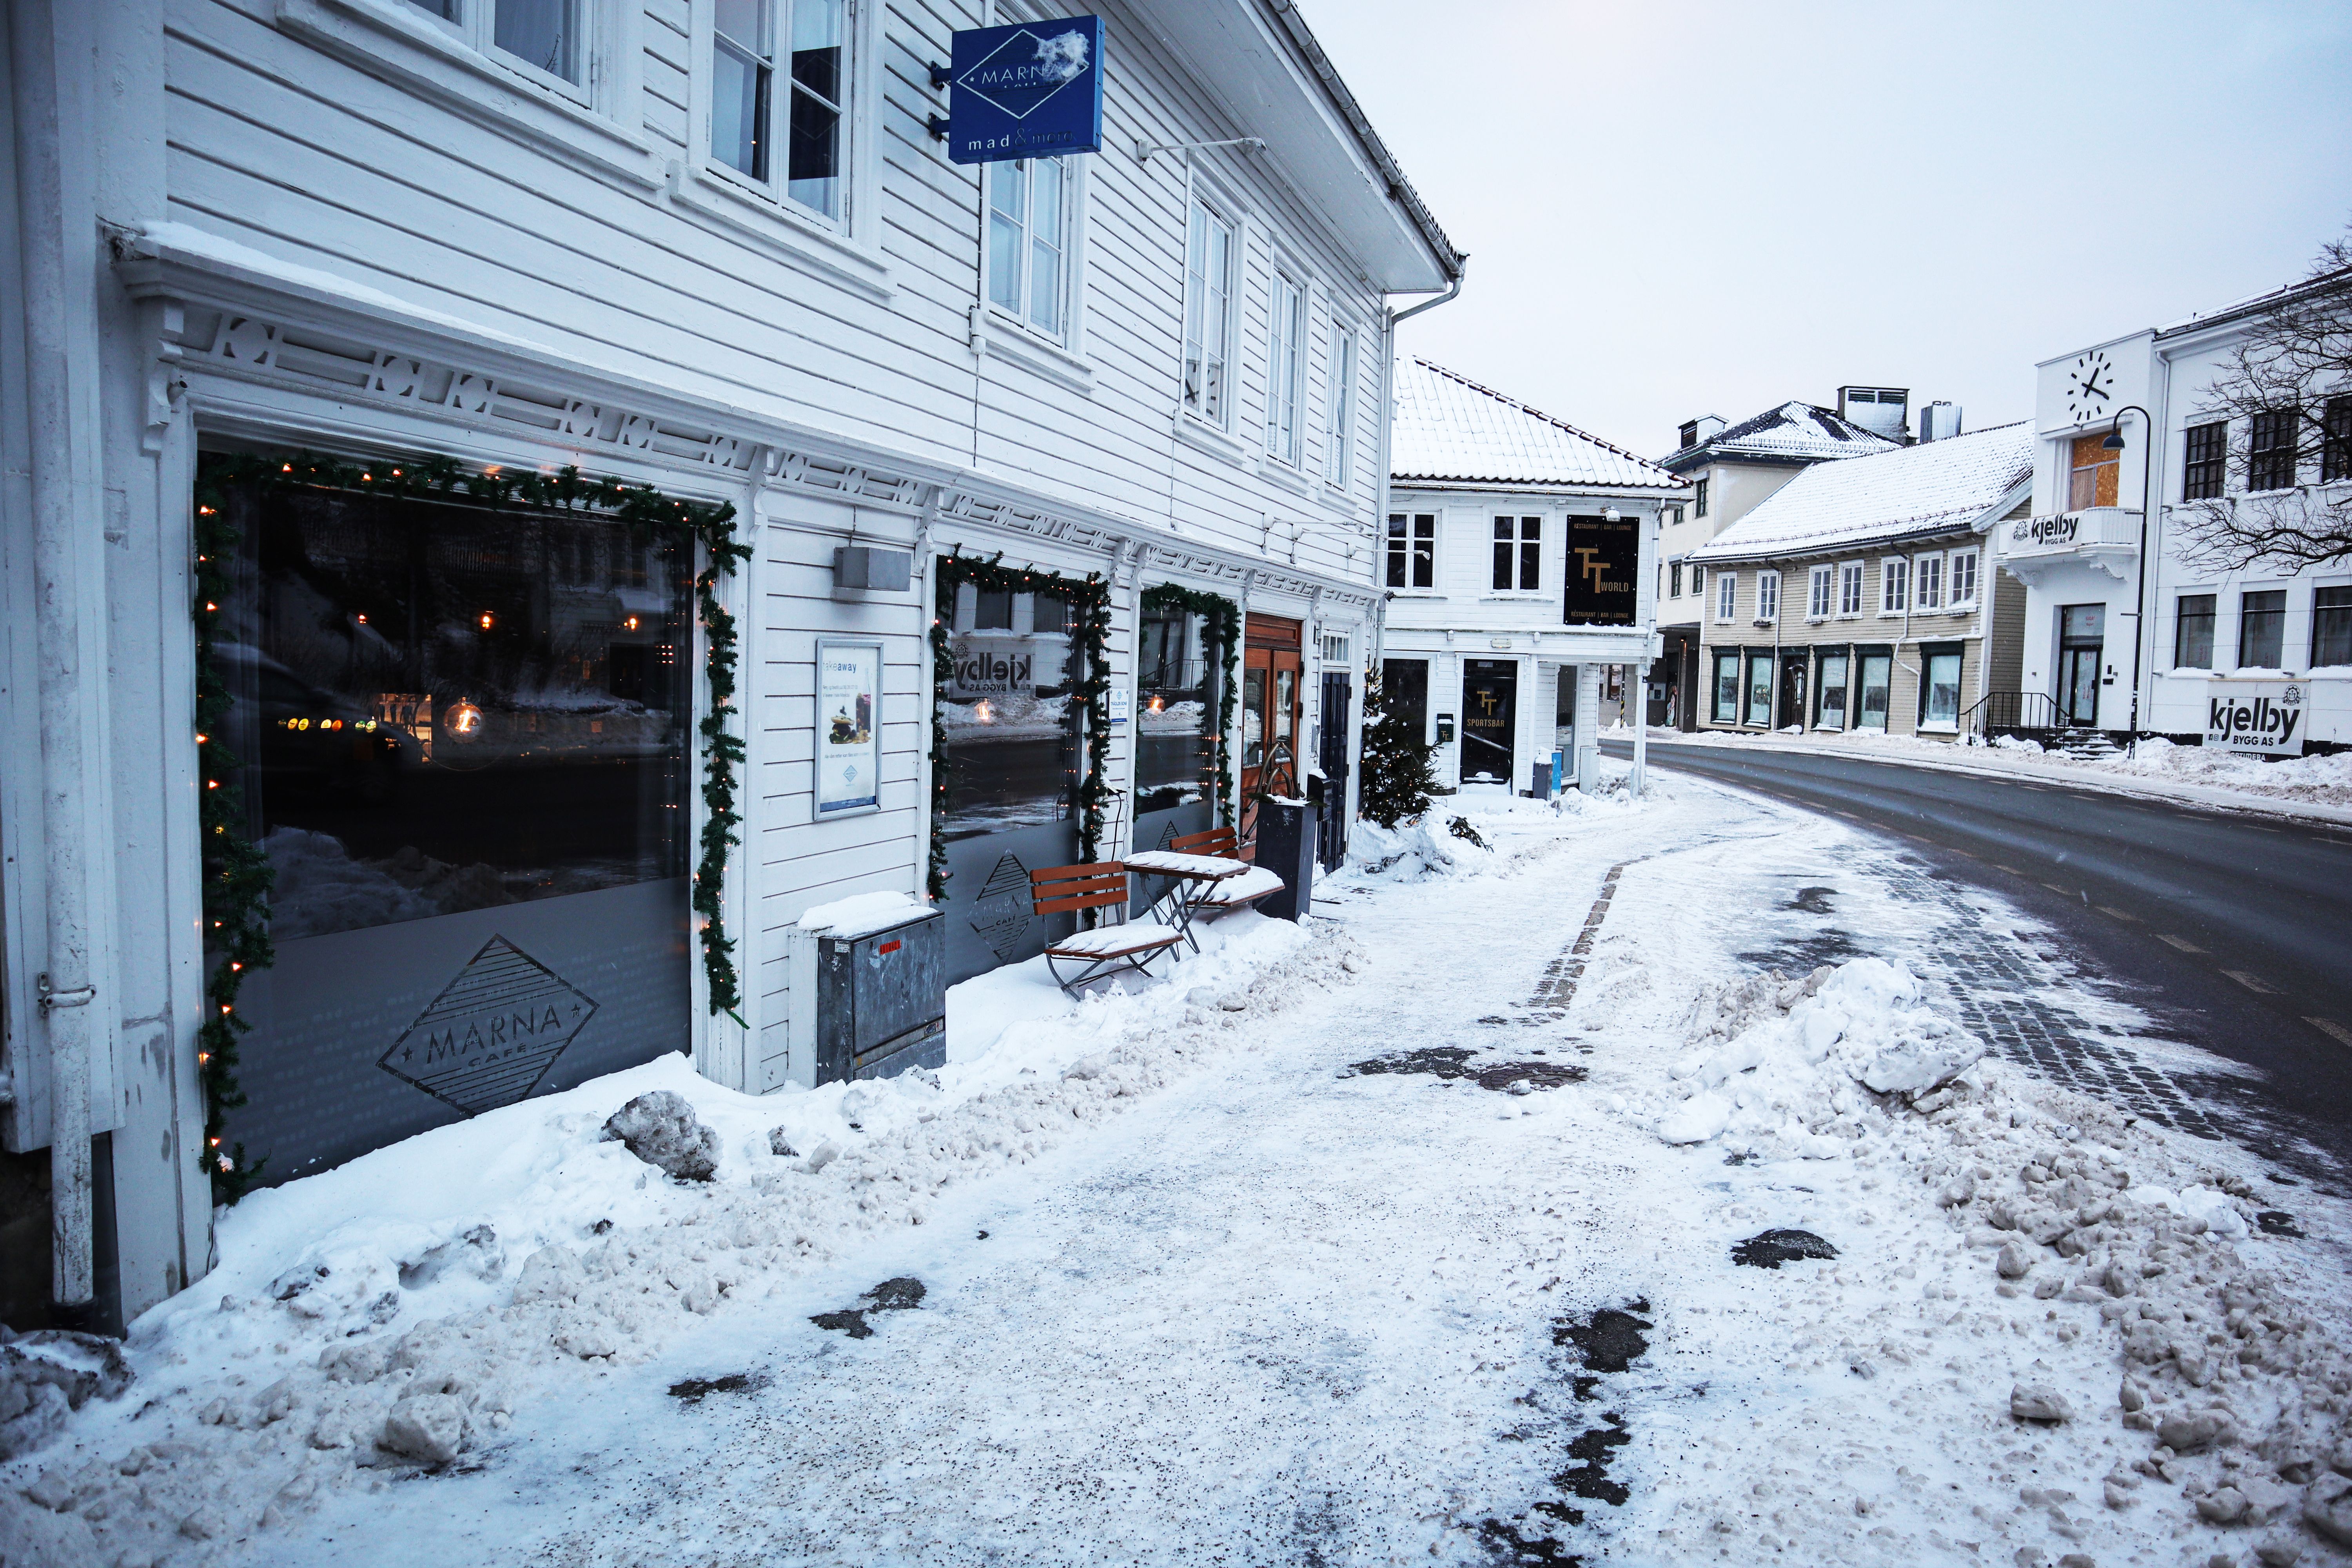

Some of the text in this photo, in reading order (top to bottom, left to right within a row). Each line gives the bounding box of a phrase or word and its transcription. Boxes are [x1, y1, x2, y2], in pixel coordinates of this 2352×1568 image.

[2031, 514, 2079, 544] kjelby
[1601, 582, 1629, 592] WORLD
[822, 661, 856, 673] takeaway
[1467, 719, 1504, 727] SPORTSBAR
[2210, 698, 2300, 745] kjelby
[2233, 735, 2274, 746] BYGG AS
[2230, 752, 2266, 761] PTIMERA
[427, 1002, 561, 1064] MARNA
[468, 1043, 526, 1067] CAFÉ
